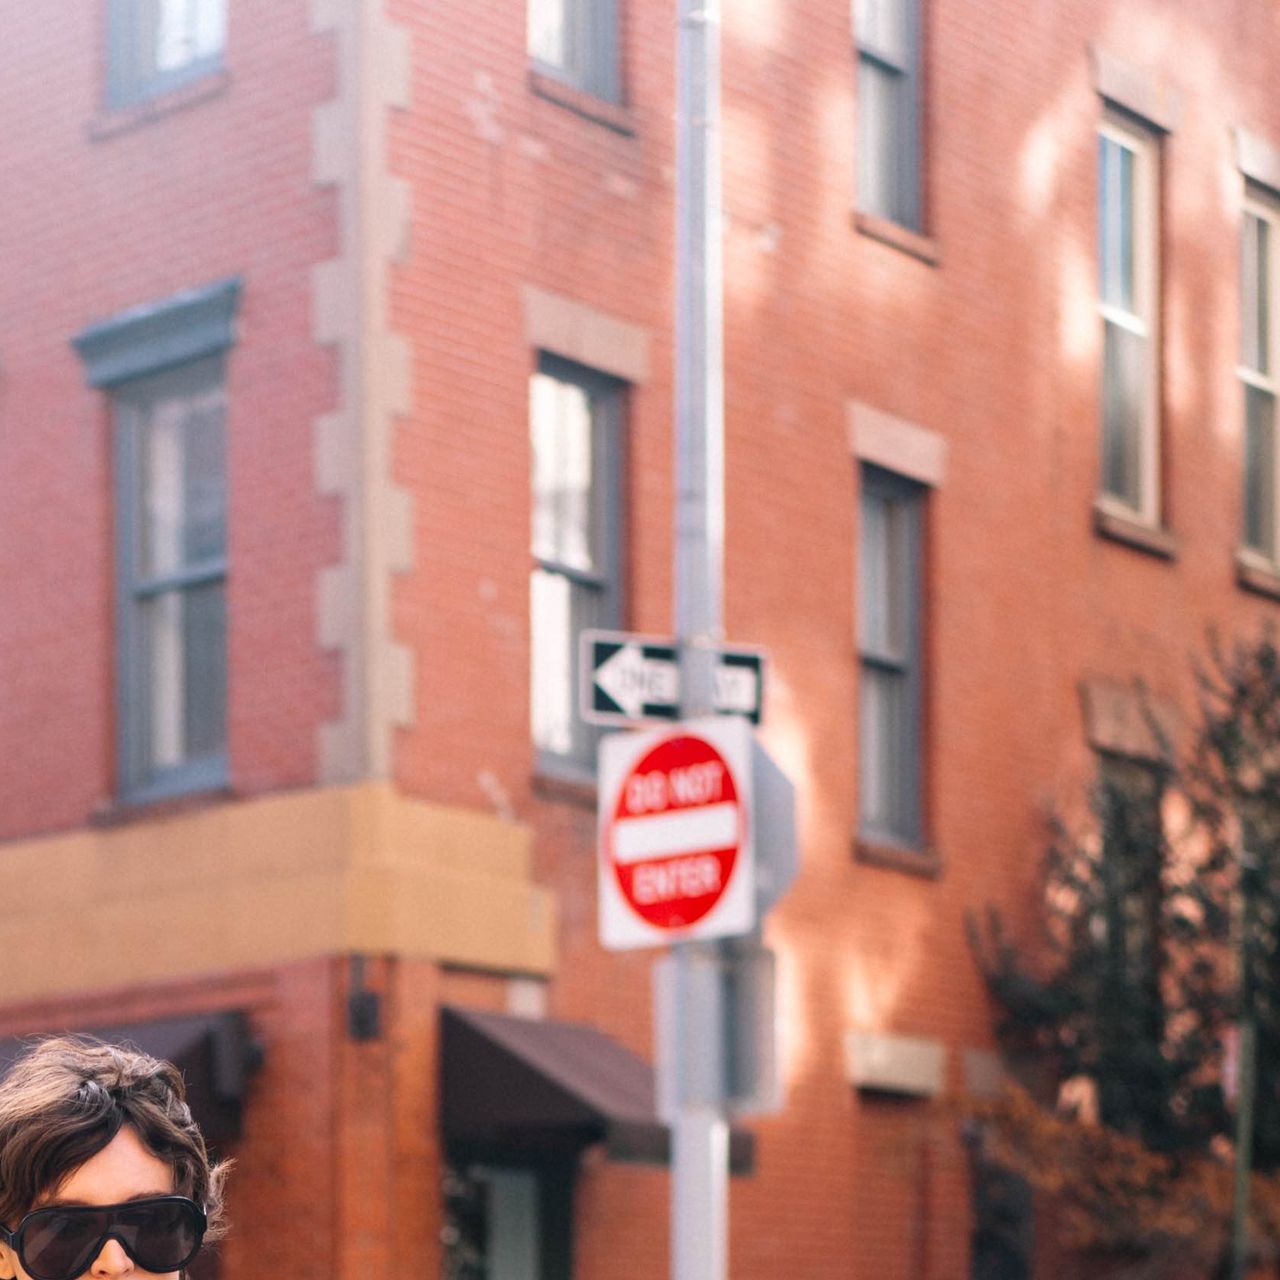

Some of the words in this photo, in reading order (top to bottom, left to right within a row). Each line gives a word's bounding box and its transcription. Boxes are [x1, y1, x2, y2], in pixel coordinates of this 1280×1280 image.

[626, 772, 666, 813] DO
[670, 761, 722, 805] NOT
[633, 856, 719, 904] ENTER
